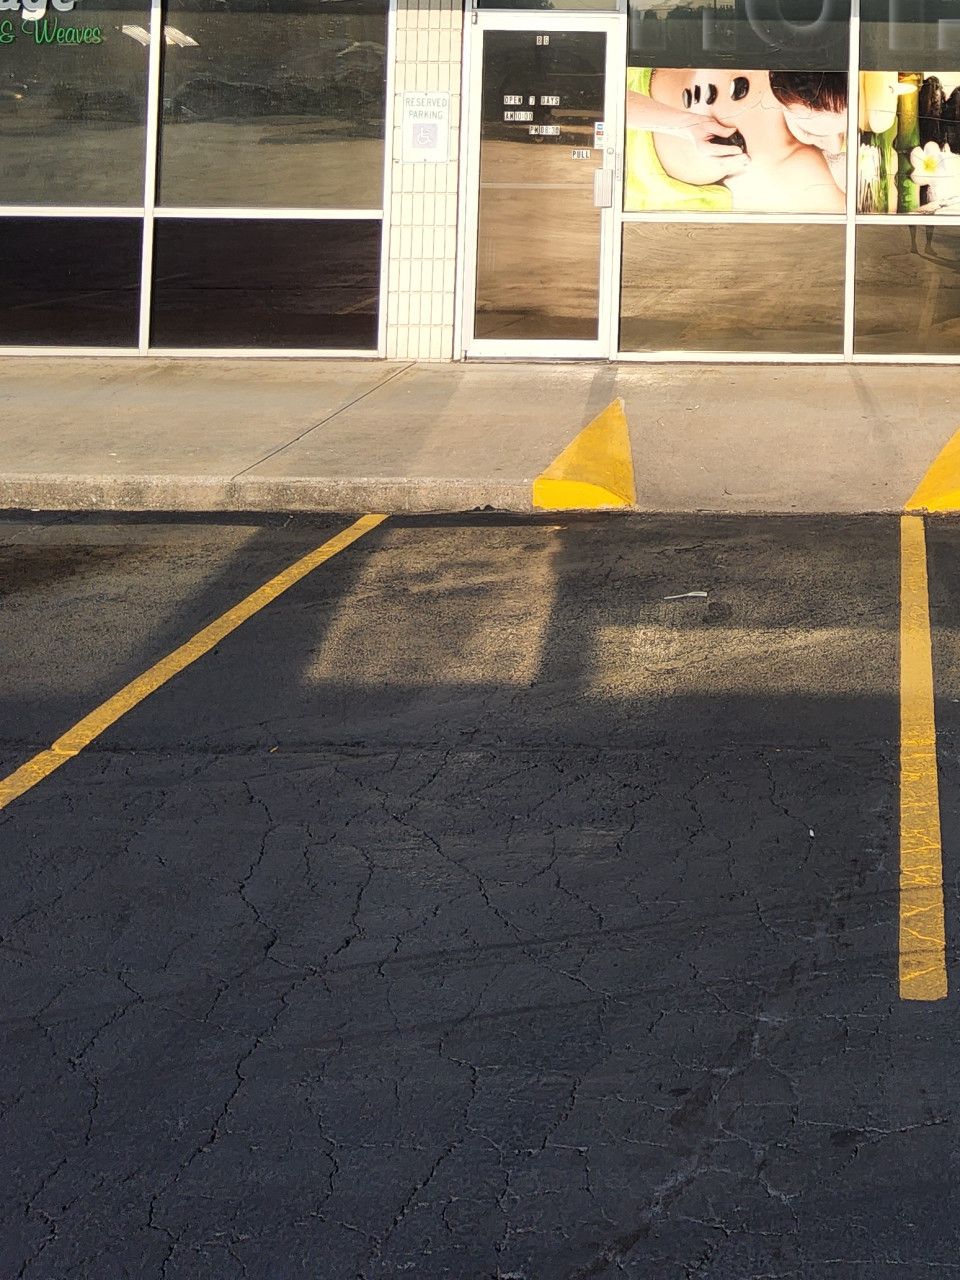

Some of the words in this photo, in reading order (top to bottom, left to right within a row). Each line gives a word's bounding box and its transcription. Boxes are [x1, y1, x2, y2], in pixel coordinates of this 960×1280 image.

[22, 17, 103, 44] Weaves
[405, 97, 448, 108] RESERVED
[504, 96, 522, 104] OPEN
[541, 96, 559, 105] DAYS
[408, 110, 443, 119] PARKING
[572, 150, 590, 158] PULL
